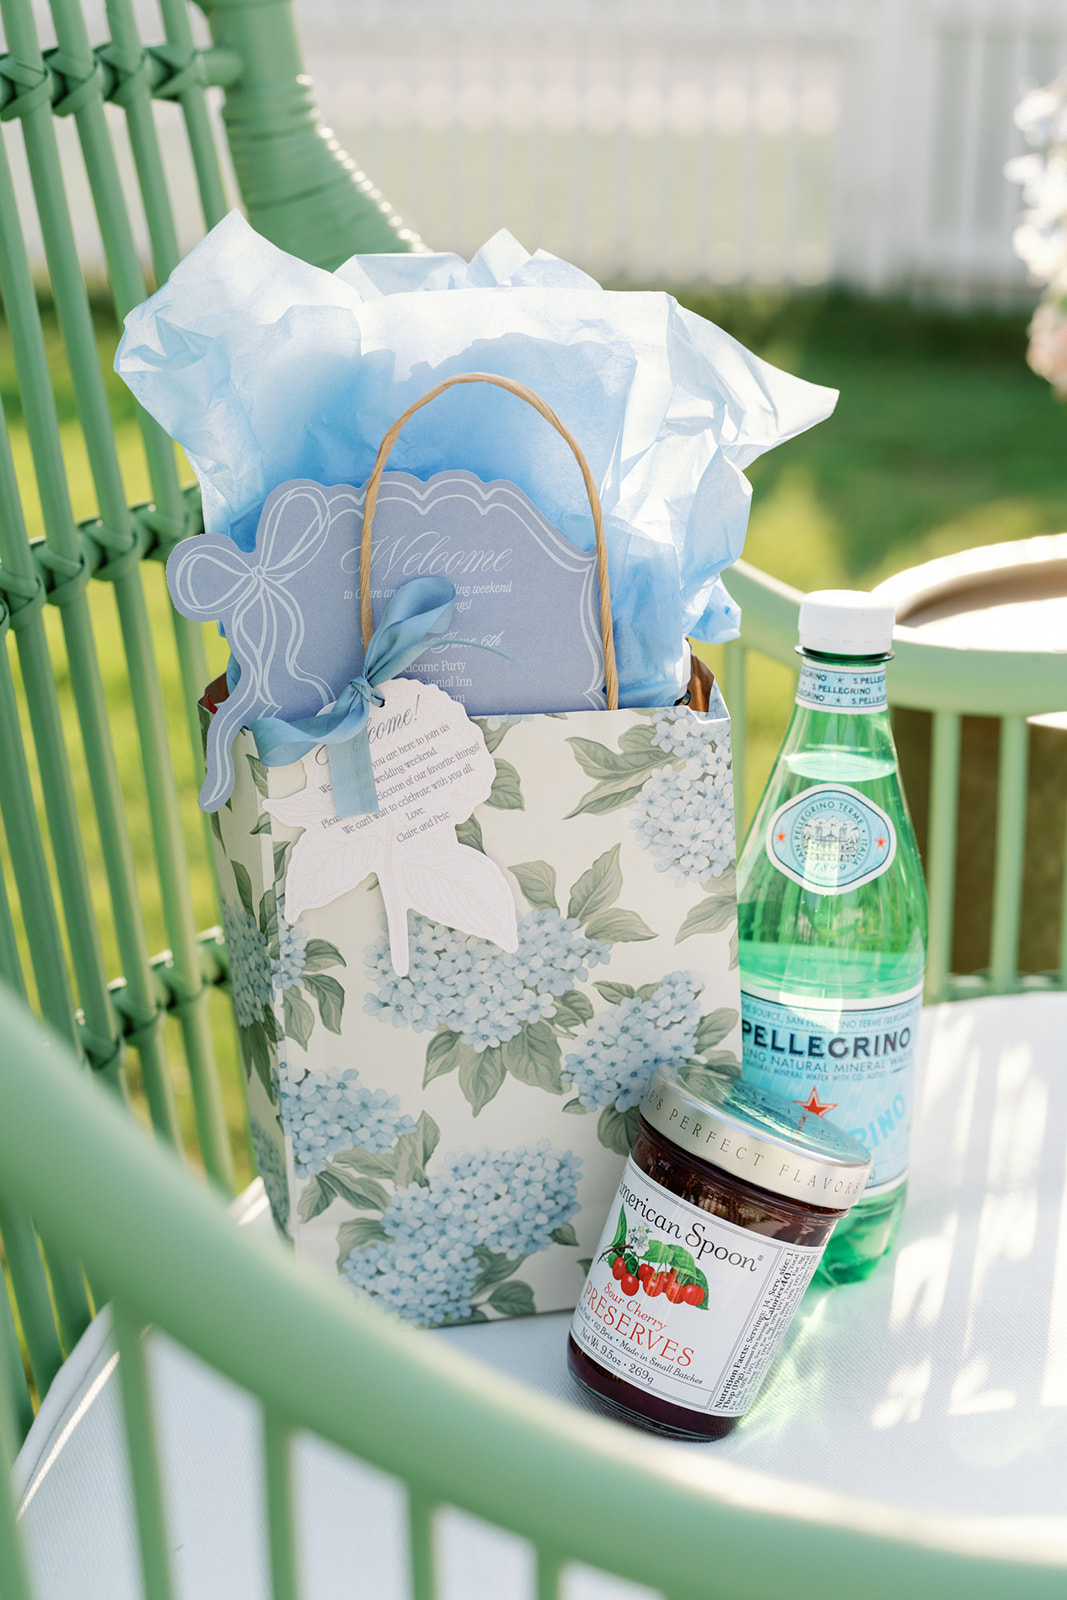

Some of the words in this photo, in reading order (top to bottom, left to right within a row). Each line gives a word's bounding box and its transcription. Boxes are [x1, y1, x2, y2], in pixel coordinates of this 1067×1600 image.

[340, 531, 512, 580] Welcome
[343, 590, 353, 600] to
[355, 588, 382, 600] Cire
[473, 581, 512, 594] weekend
[481, 630, 505, 647] 6th
[404, 663, 439, 673] elcome
[441, 661, 467, 673] Party
[456, 676, 472, 687] Inn
[386, 749, 399, 761] are
[397, 741, 416, 755] here
[415, 736, 425, 745] to
[424, 728, 440, 744] join
[439, 723, 450, 734] us
[374, 764, 405, 784] wedding
[377, 782, 406, 801] election
[405, 775, 414, 786] of
[413, 771, 427, 782] our
[426, 756, 456, 776] favorite
[454, 741, 481, 760] things!
[342, 823, 356, 835] We
[355, 815, 373, 829] can't
[372, 807, 389, 820] wait
[388, 803, 398, 813] to
[397, 785, 432, 808] celebrate
[431, 776, 448, 790] with
[448, 769, 463, 784] you
[794, 801, 835, 840] PELLEGRINO
[840, 802, 865, 826] TERME
[396, 826, 420, 843] Claire
[419, 817, 434, 832] and
[432, 811, 450, 825] Pete
[771, 1055, 828, 1073] NATURAL
[834, 1060, 885, 1073] MINERAL
[669, 1108, 764, 1167] PERFECT
[779, 1164, 861, 1195] FLAVORS
[619, 1183, 682, 1239] merican
[583, 1280, 695, 1367] PRESERVES
[604, 1281, 625, 1304] Sour
[627, 1299, 667, 1332] Cherry
[600, 1345, 621, 1366] 9.5oz
[628, 1363, 654, 1385] 269g
[620, 1340, 639, 1357] Made
[640, 1353, 648, 1362] in
[649, 1356, 673, 1373] Small
[673, 1367, 703, 1385] Batches
[721, 1390, 735, 1410] Tbsp
[763, 1285, 785, 1321] Calories
[714, 1367, 738, 1409] Nutrition
[733, 1343, 749, 1368] Facts:
